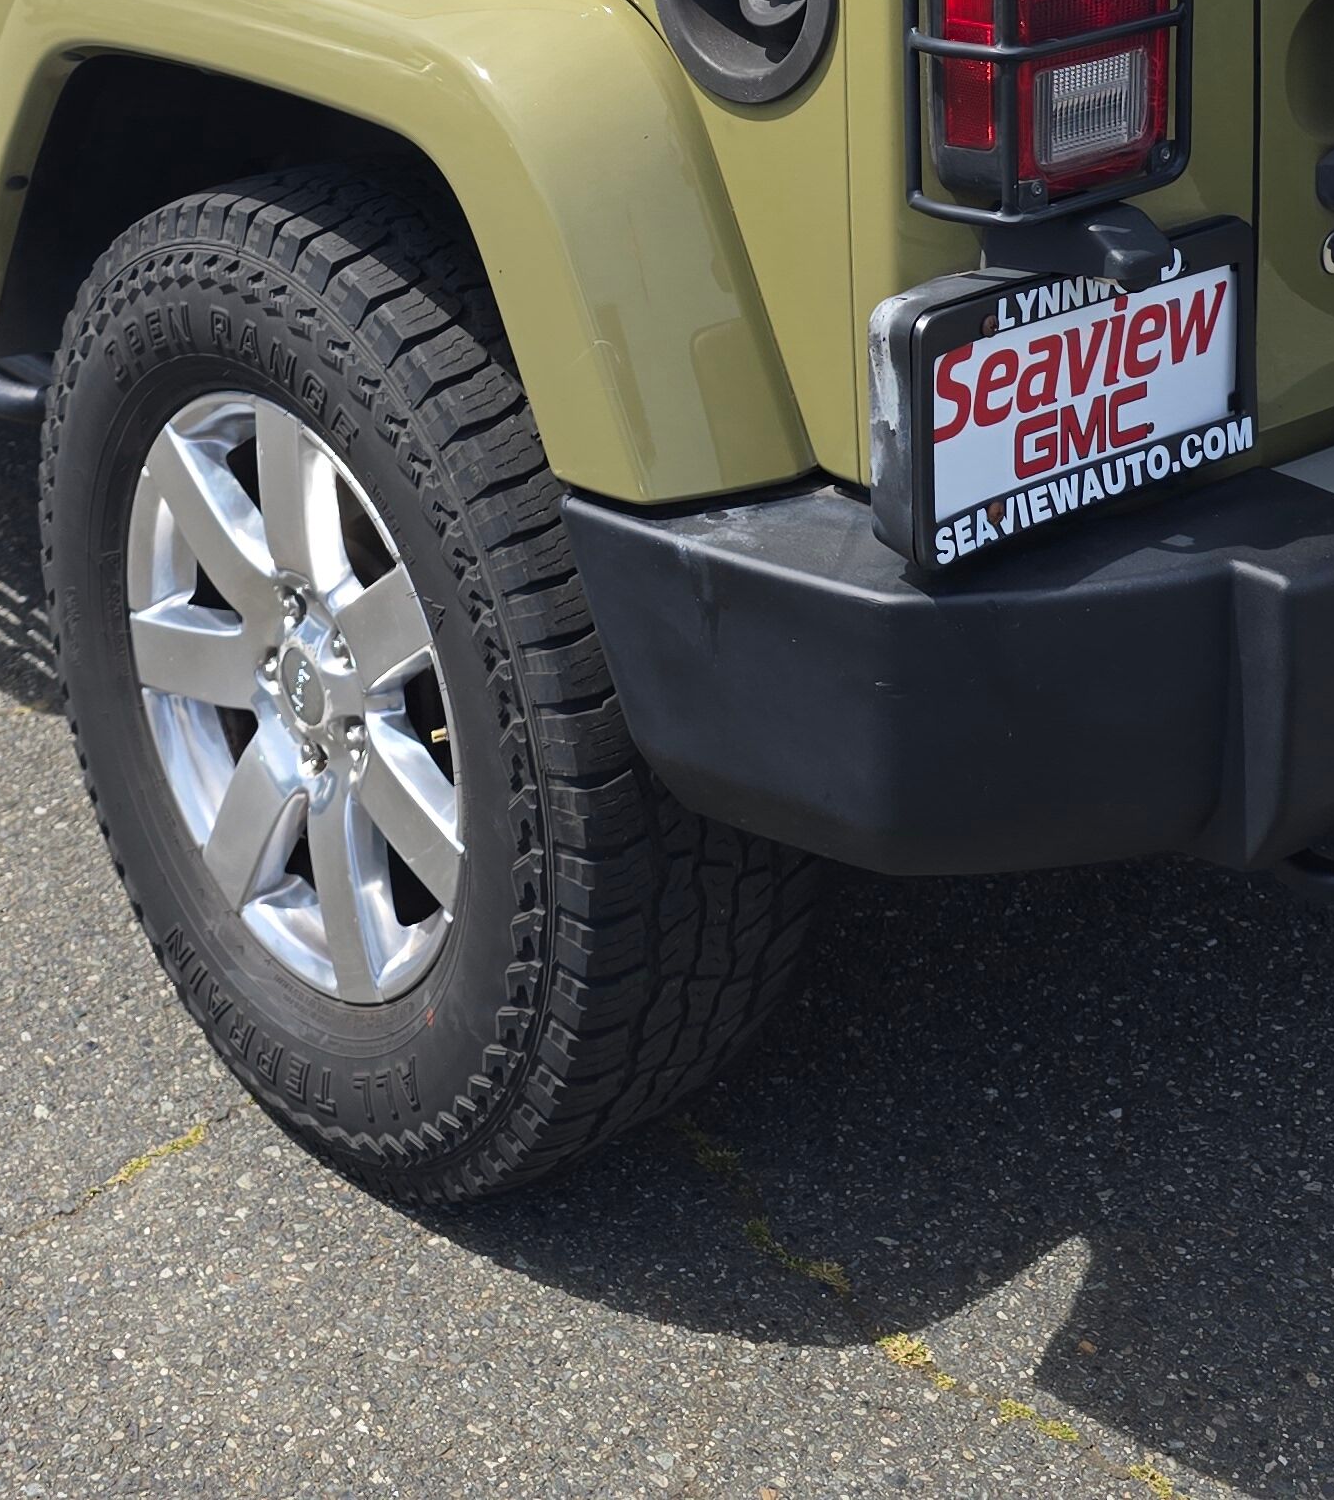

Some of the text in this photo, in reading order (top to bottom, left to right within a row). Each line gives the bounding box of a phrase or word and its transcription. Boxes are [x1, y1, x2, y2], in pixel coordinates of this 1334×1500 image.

[103, 300, 359, 450] OPEN RANGE
[933, 281, 1227, 443] Seaview
[1014, 381, 1149, 480] GMC
[934, 417, 1253, 565] SEAVIEWAUTO.COM
[164, 922, 337, 1117] TERRAIN
[352, 1055, 421, 1123] ALL
